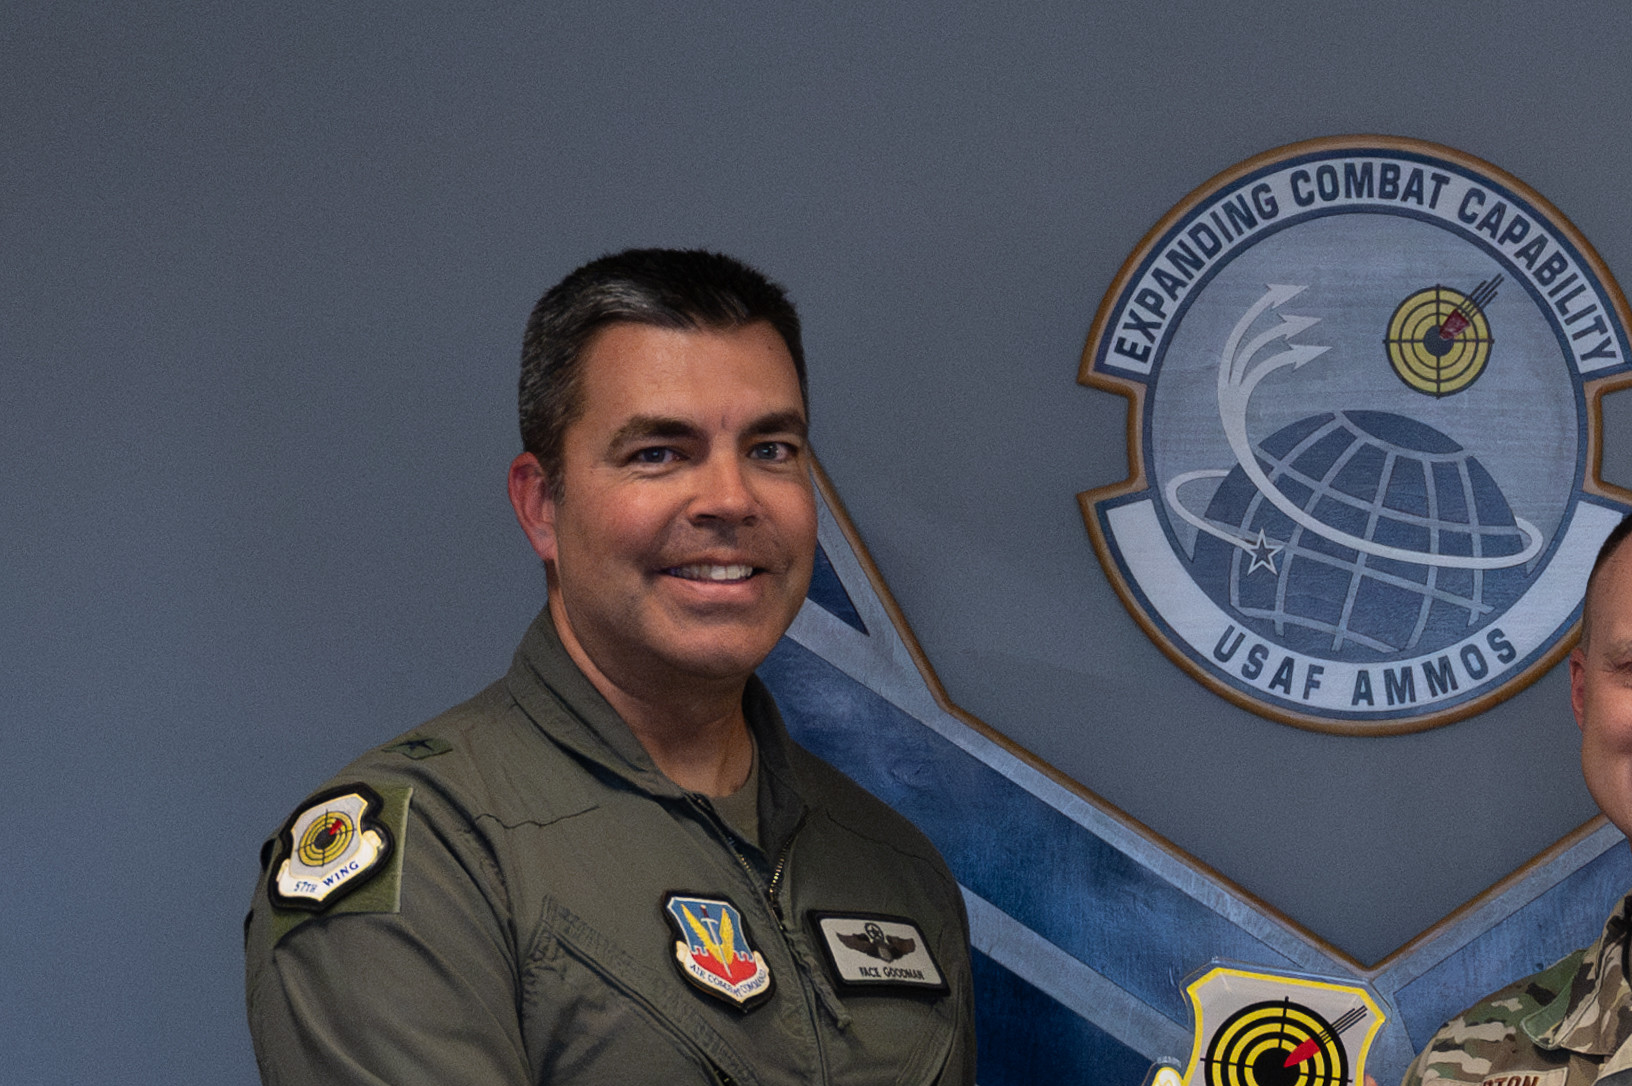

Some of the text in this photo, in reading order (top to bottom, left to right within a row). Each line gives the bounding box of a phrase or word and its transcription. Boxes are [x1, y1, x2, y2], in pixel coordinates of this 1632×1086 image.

[1115, 160, 1619, 367] EXPANDING COMBAT CAPABILITY
[1211, 624, 1518, 708] USAF AMMOS
[322, 860, 360, 887] WING
[690, 964, 706, 980] AIR
[882, 966, 925, 981] GOODMAN
